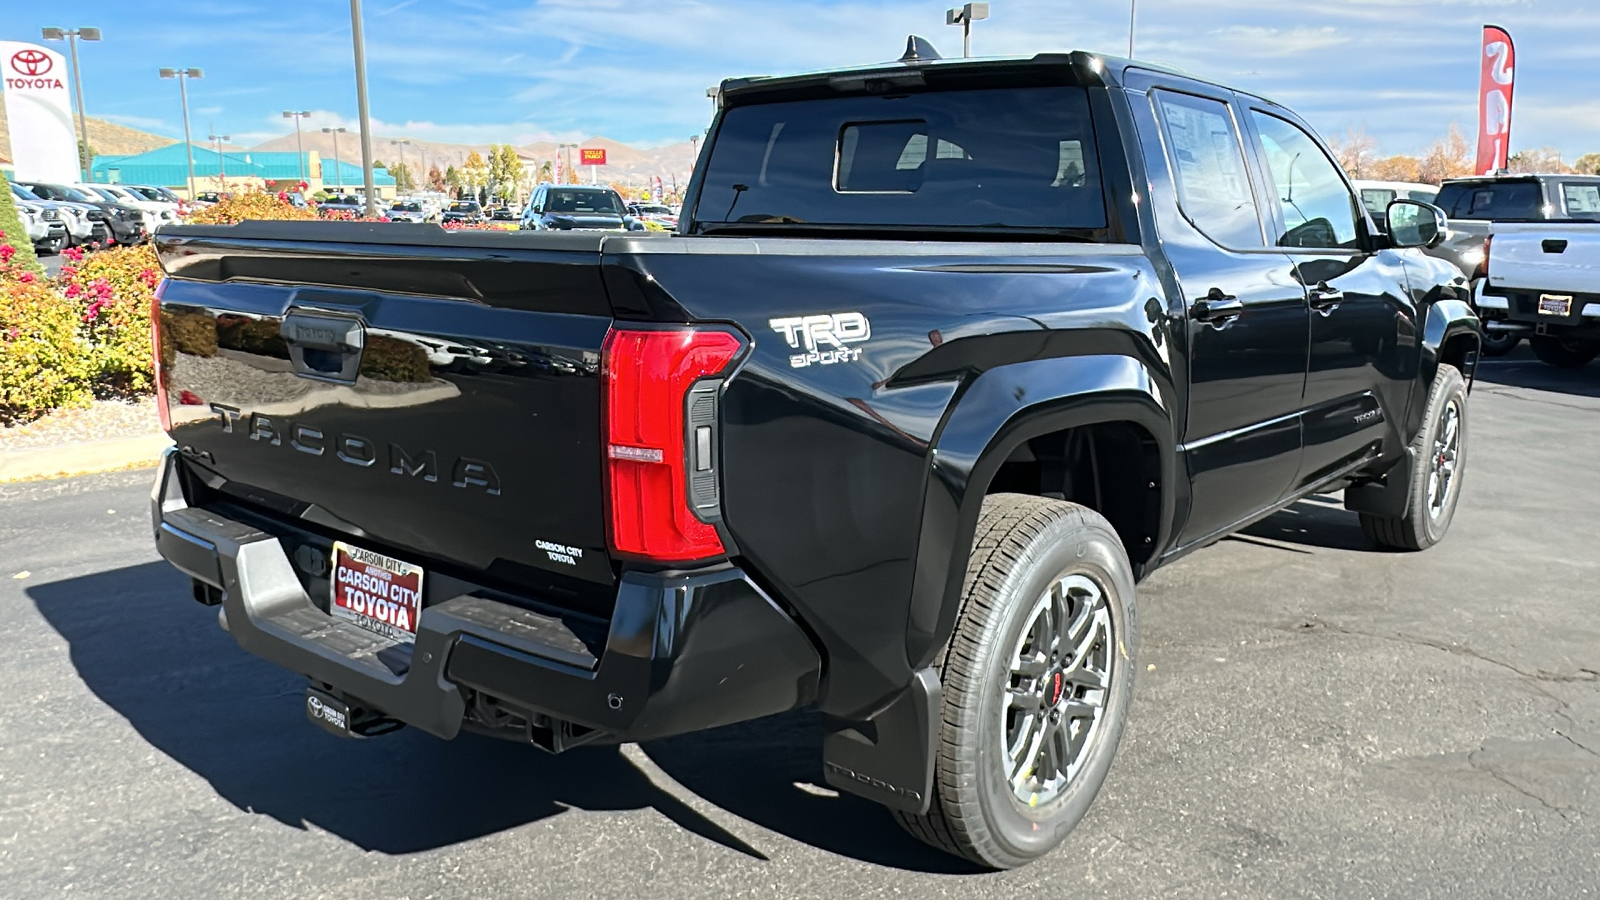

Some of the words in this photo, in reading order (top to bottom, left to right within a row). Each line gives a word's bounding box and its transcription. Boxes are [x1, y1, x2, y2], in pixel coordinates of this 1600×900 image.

[5, 78, 64, 89] TOYOTA
[769, 312, 871, 354] TRD
[789, 347, 863, 368] SPORT
[210, 402, 502, 496] TACOMA
[354, 548, 384, 568] CARSON
[385, 557, 402, 573] CITY
[535, 540, 566, 554] CARSON
[566, 546, 583, 557] CITY
[547, 551, 576, 565] TOYOTA
[338, 566, 389, 598] CARSON
[390, 584, 420, 608] CITY
[344, 586, 411, 631] TOYOTA
[354, 613, 395, 637] TOYOTA
[324, 712, 346, 729] TOYOTA
[826, 760, 921, 802] TACOMA
